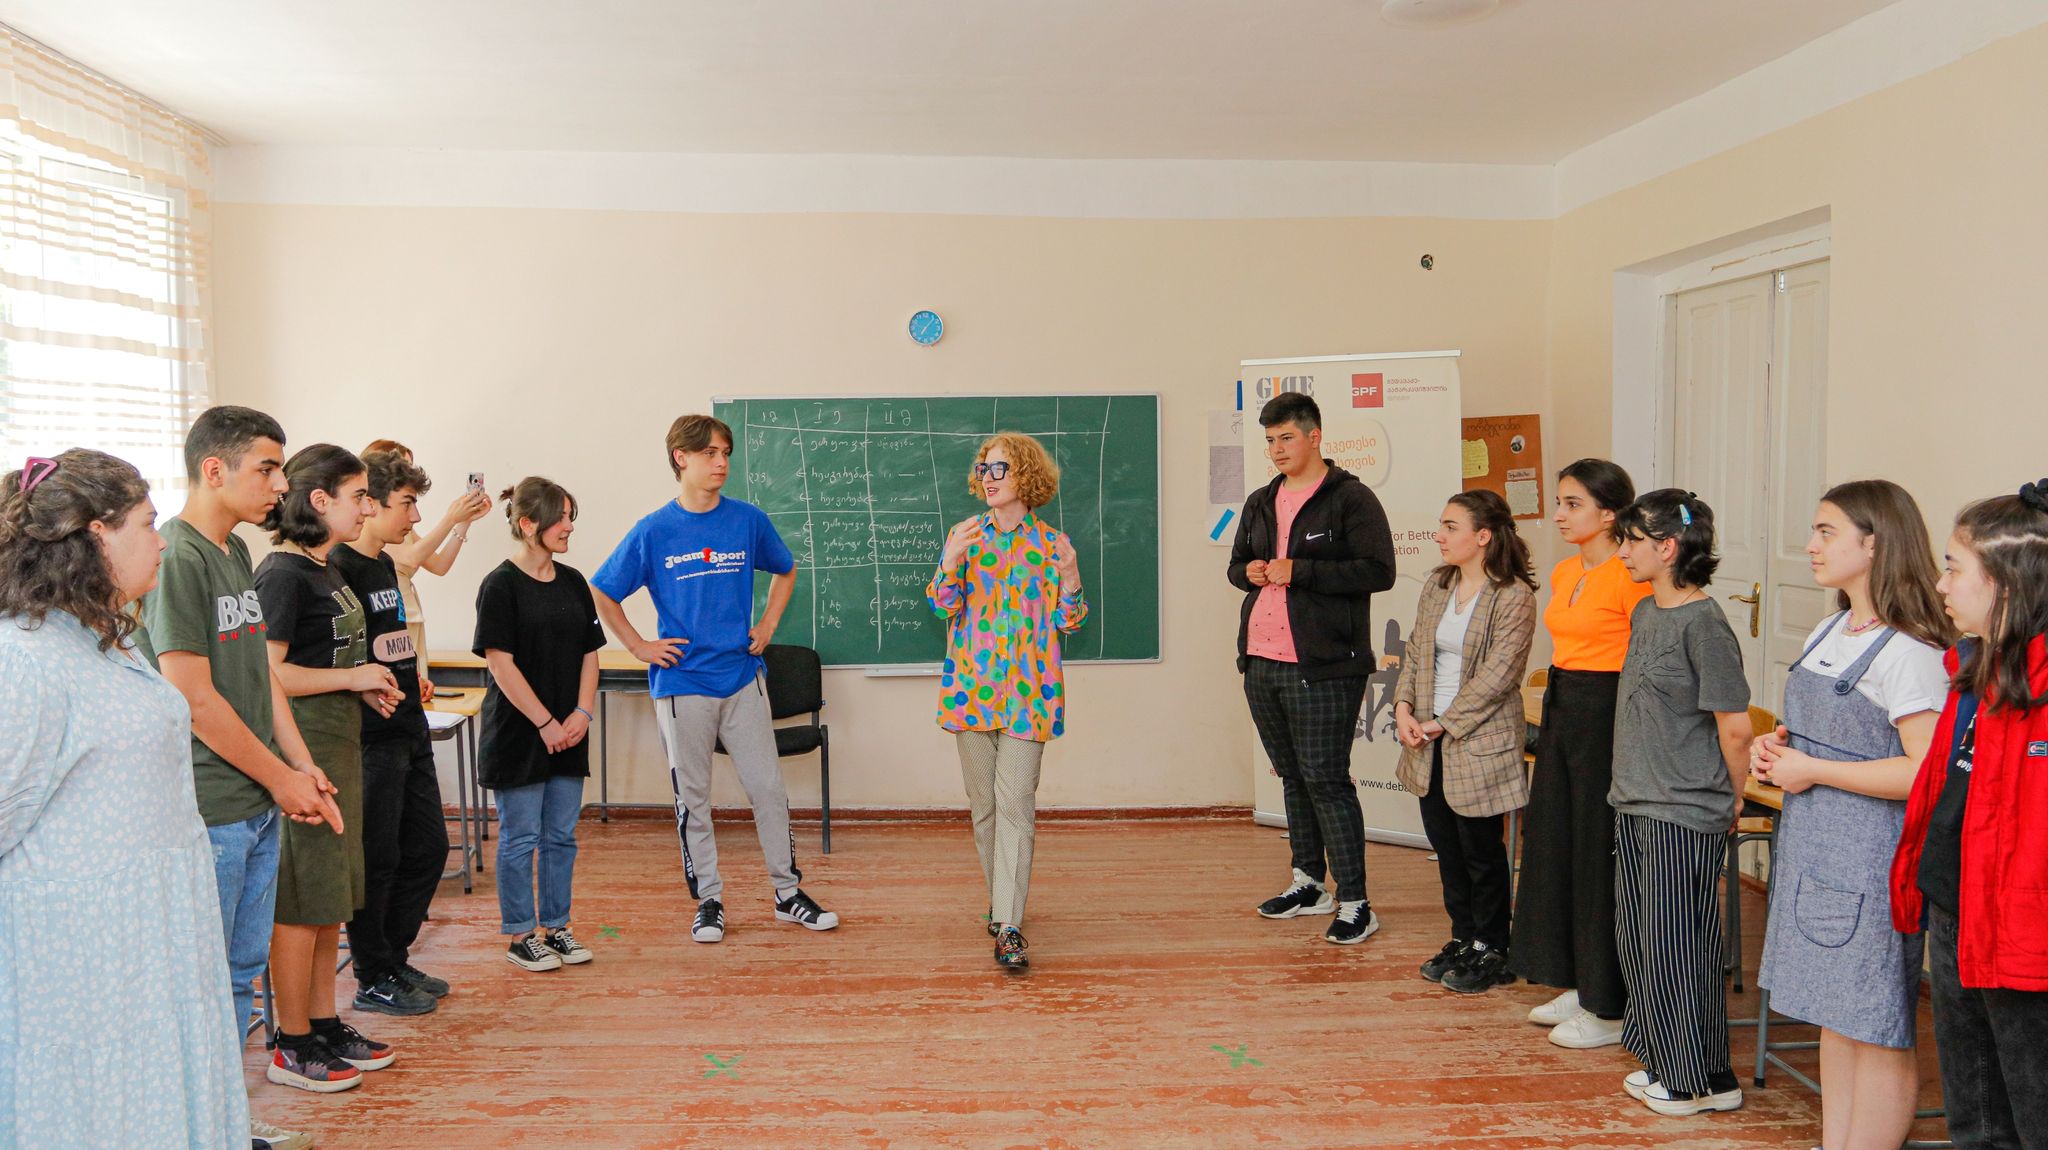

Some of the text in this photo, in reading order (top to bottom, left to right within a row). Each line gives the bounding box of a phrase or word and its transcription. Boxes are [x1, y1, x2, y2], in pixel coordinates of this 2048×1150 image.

[1352, 386, 1378, 397] GPF
[1408, 530, 1438, 541] Bette
[1393, 544, 1420, 556] ation
[709, 551, 746, 563] Sport
[1359, 778, 1410, 793] www.deba
